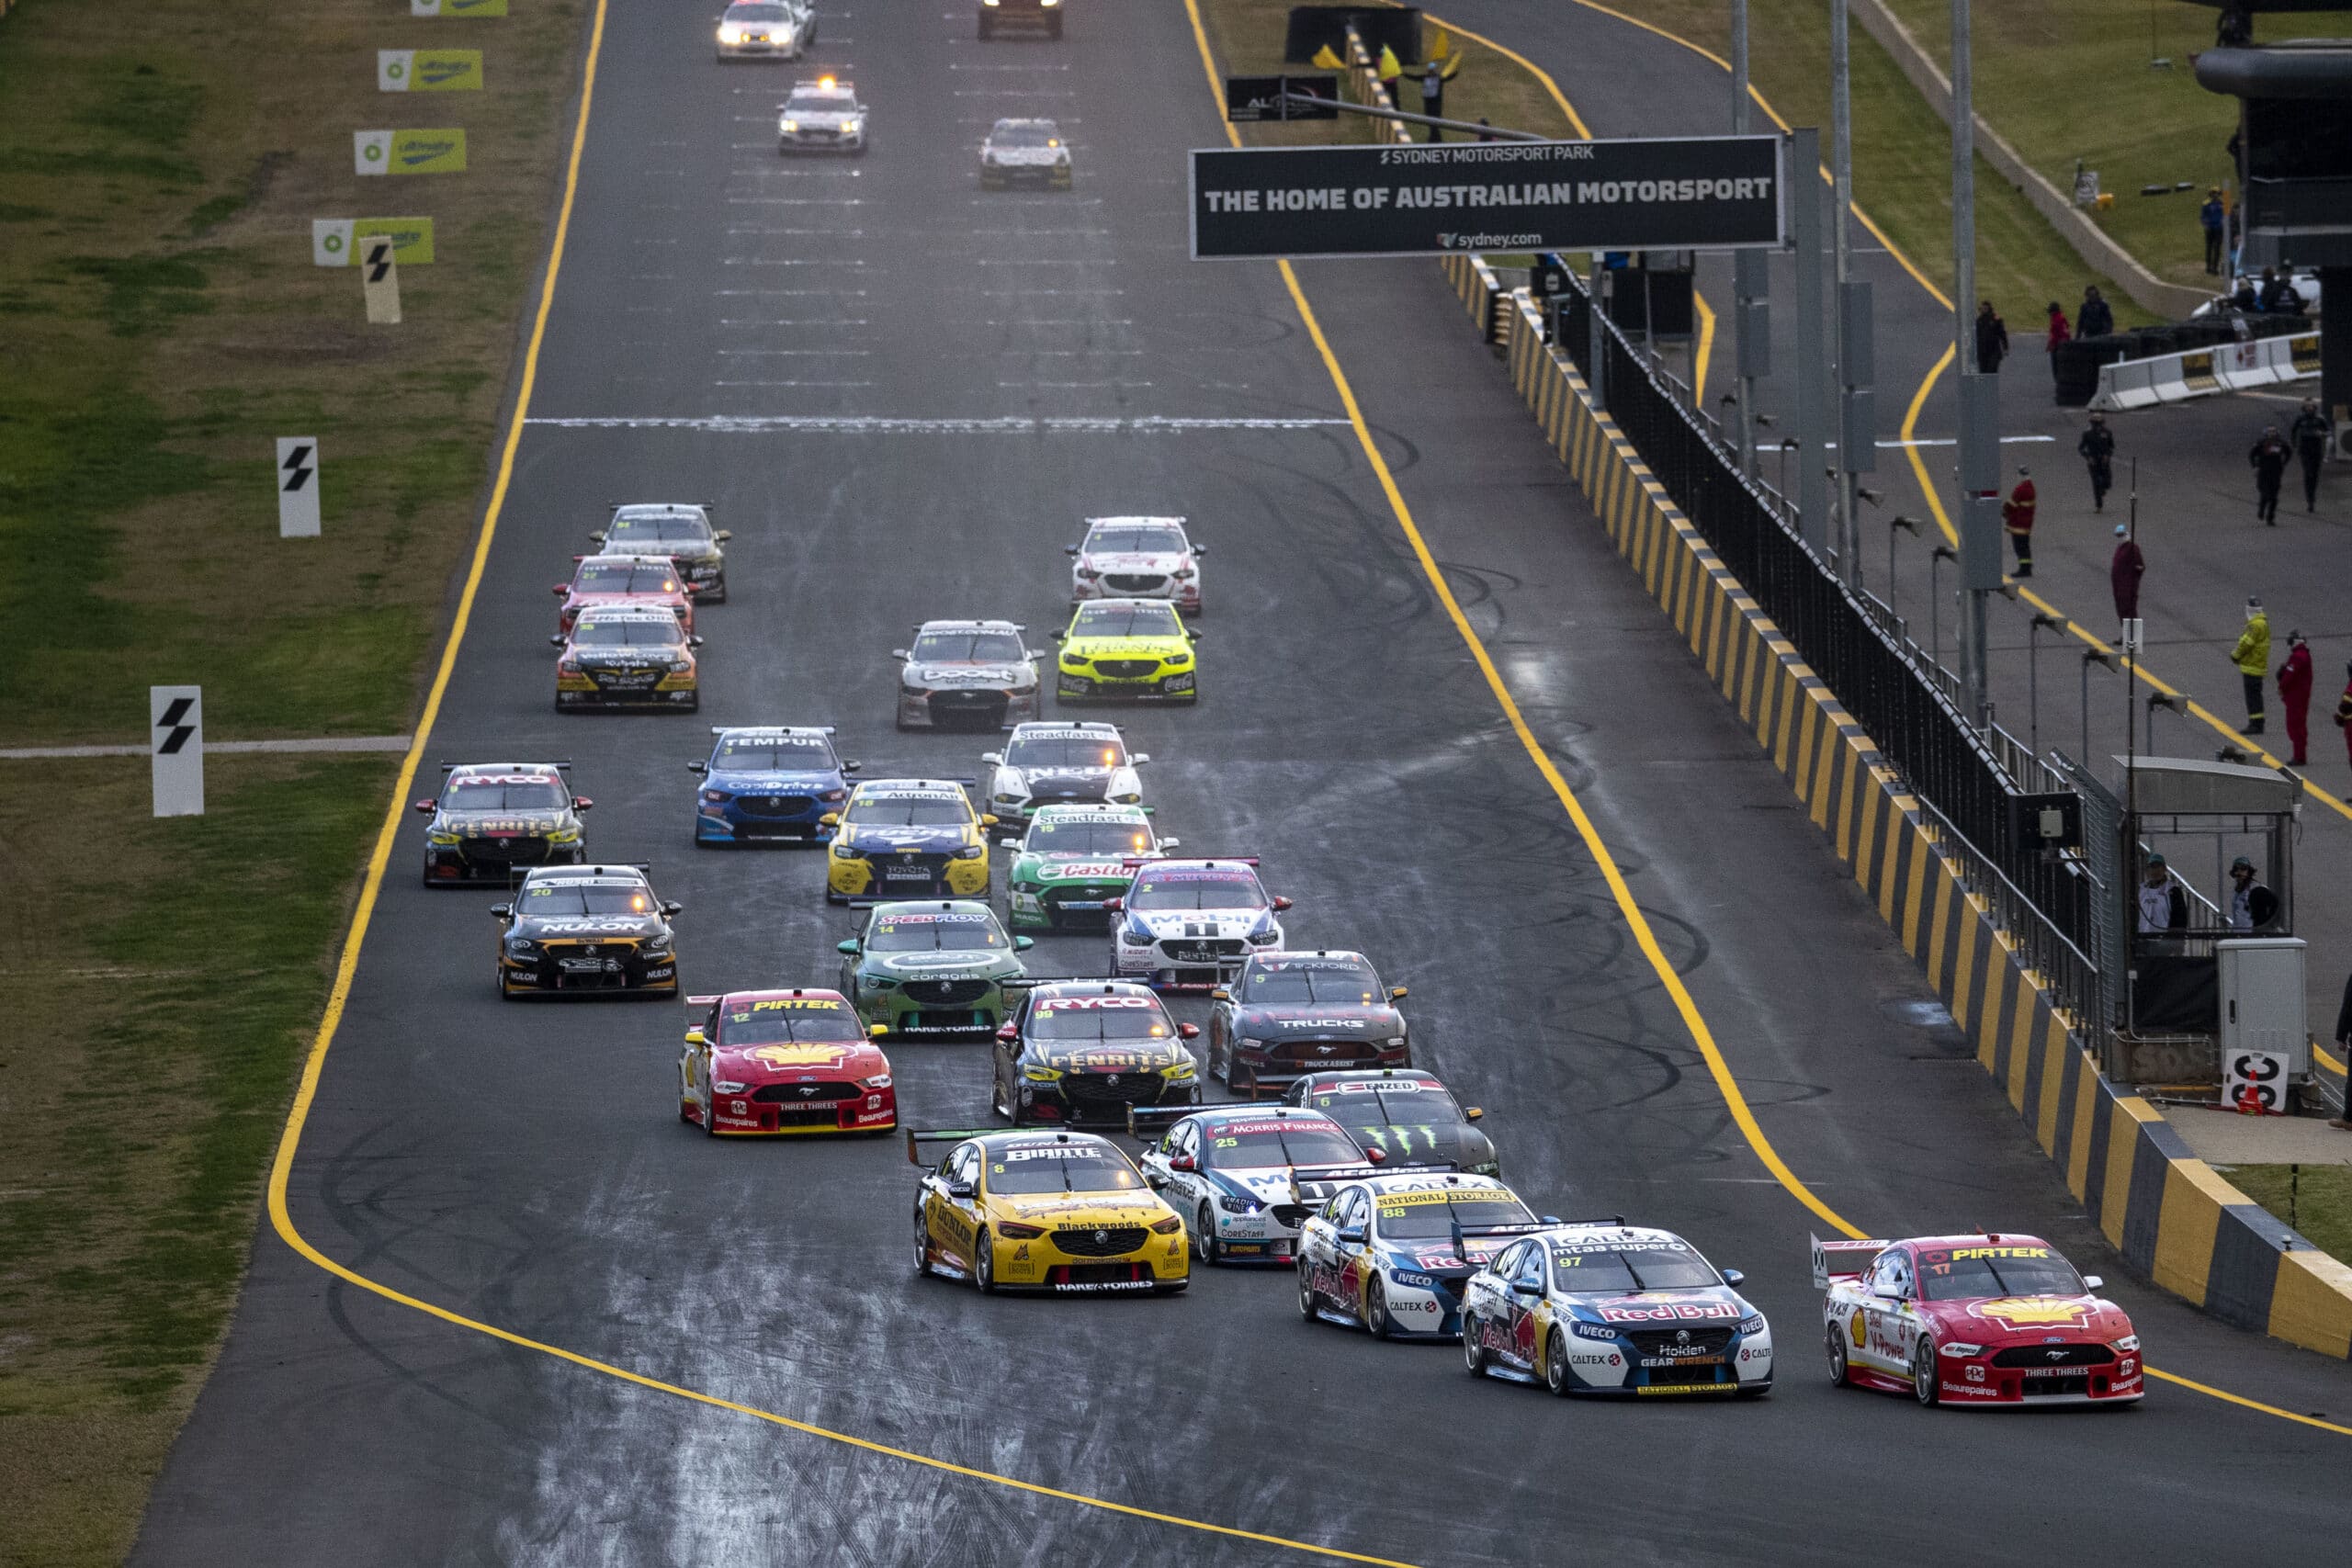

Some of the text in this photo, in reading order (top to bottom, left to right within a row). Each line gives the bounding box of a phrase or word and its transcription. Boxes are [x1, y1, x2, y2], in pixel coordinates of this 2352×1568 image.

[1392, 145, 1594, 164] SYDNEY MOTORSPORT PARK
[1204, 177, 1771, 212] THE HOME OF AUSTRALIAN MOTORSPORT
[1458, 232, 1542, 249] sydney.com
[1020, 730, 1095, 739] Steadfast
[725, 738, 823, 747] TEMPUR
[456, 774, 551, 786] RYCO
[728, 781, 824, 790] CoolDrive
[888, 792, 958, 800] ActronAir
[1039, 814, 1122, 824] Steadfast
[451, 820, 553, 833] PENRITE
[1064, 863, 1137, 876] Castro
[531, 888, 552, 897] 20
[1142, 884, 1152, 893] 2
[878, 914, 989, 924] SPEEDFLOW
[1151, 914, 1250, 925] Mobil
[540, 922, 645, 932] NULON
[647, 967, 673, 978] NULON
[1255, 975, 1265, 983] 5
[752, 999, 841, 1012] PIRTEK
[1042, 998, 1150, 1010] RYCO
[731, 1013, 751, 1023] 12
[1035, 1010, 1054, 1019] 99
[1278, 1019, 1365, 1029] TRUCKS
[1051, 1054, 1170, 1067] PENRITE
[1365, 1082, 1412, 1090] ENZED
[808, 1101, 838, 1110] THREES
[1320, 1097, 1330, 1107] 6
[715, 1113, 758, 1127] Beaurepaires
[1233, 1122, 1338, 1134] MORRIS FINANCE
[1216, 1137, 1238, 1148] 25
[1006, 1147, 1102, 1162] BIANTE
[993, 1164, 1005, 1174] 8
[1379, 1193, 1445, 1206] NATIONAL
[1383, 1208, 1406, 1218] 88
[938, 1206, 972, 1244] DUNLOP
[1057, 1222, 1141, 1230] Blackwoods
[1553, 1242, 1668, 1256] mtaa super
[1952, 1247, 2049, 1261] PIRTEK
[1558, 1257, 1582, 1268] 97
[1931, 1263, 1951, 1275] 17
[1397, 1272, 1432, 1286] IVECO
[1390, 1301, 1422, 1311] CALTEX
[1599, 1303, 1741, 1322] Red Bull
[1579, 1325, 1616, 1339] IVECO
[1740, 1319, 1764, 1334] IVECO
[1659, 1345, 1706, 1357] Holden
[1871, 1331, 1905, 1360] V-Power
[1571, 1355, 1606, 1365] CALTEX
[1641, 1355, 1725, 1367] GEARWRENCH
[2024, 1367, 2089, 1377] THREE THREES
[1942, 1381, 1997, 1397] Beaurepaires
